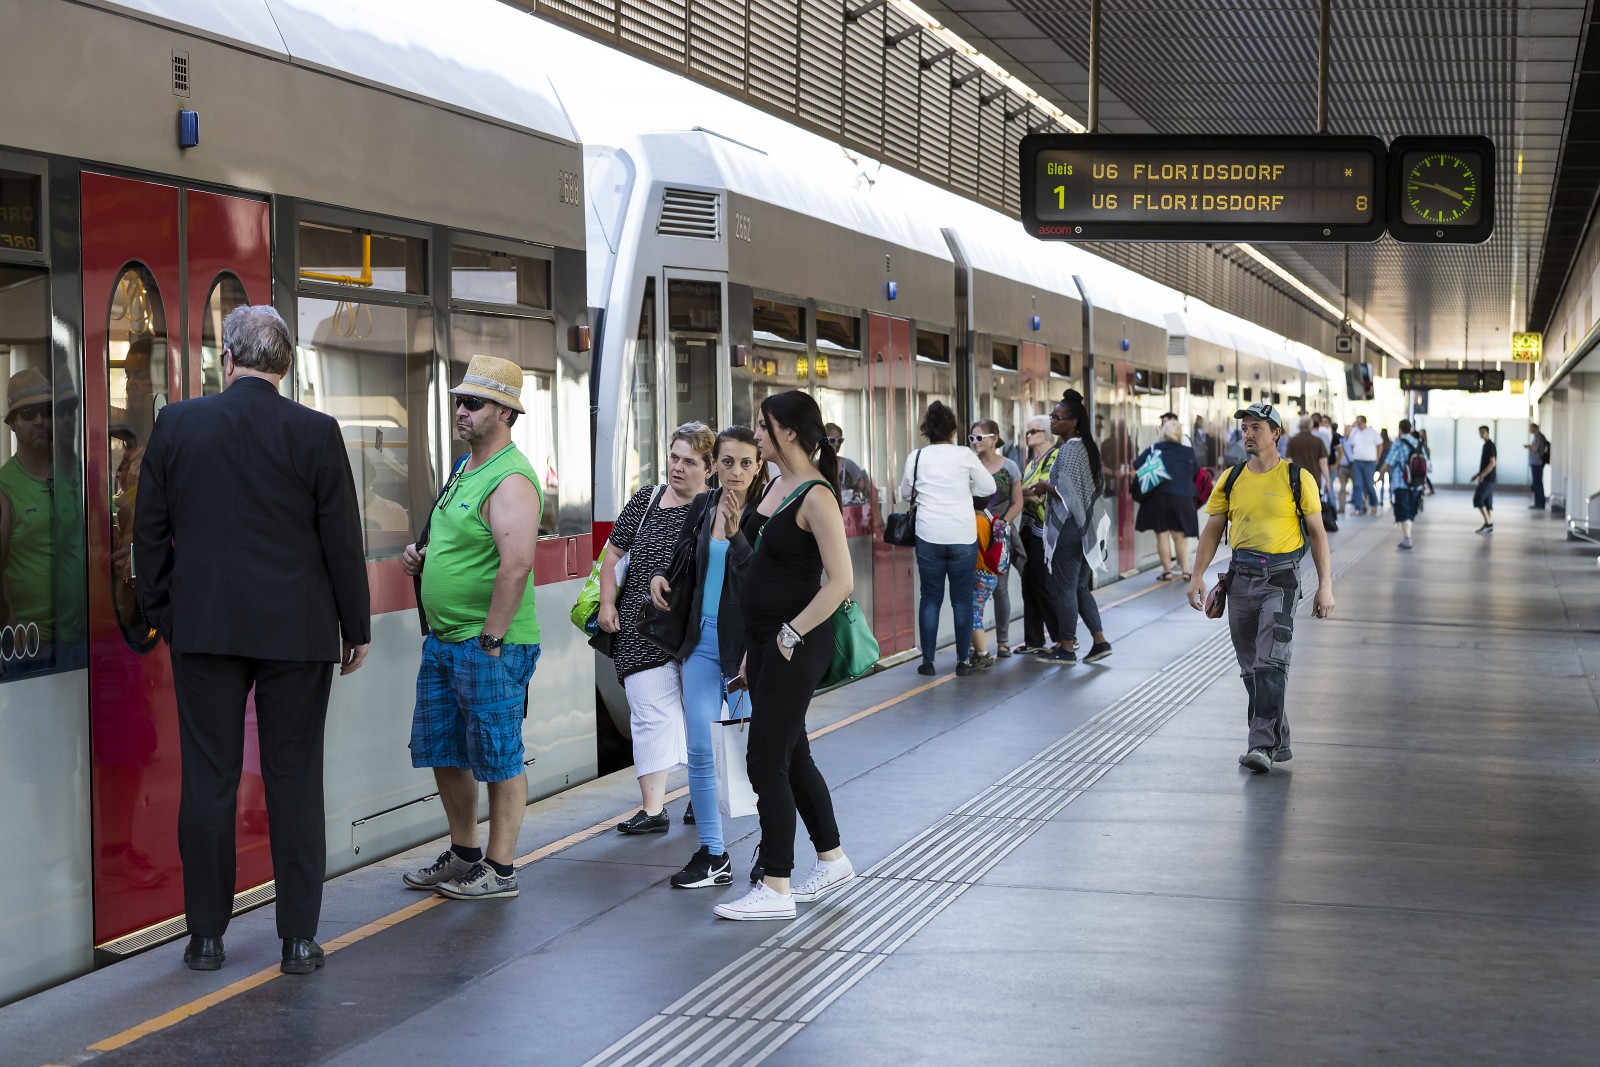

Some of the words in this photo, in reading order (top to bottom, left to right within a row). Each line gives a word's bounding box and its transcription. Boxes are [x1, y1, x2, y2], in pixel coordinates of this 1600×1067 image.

[1047, 162, 1073, 175] Gleis
[1092, 163, 1118, 179] U6
[1133, 164, 1285, 180] FLORIDSDORF
[1053, 185, 1065, 209] 1
[1092, 193, 1118, 209] U6
[1133, 194, 1284, 211] FLORIDSDORF
[1356, 195, 1368, 211] 8
[735, 212, 751, 244] 2662
[1039, 226, 1072, 235] ascom
[1513, 334, 1539, 348] SOS
